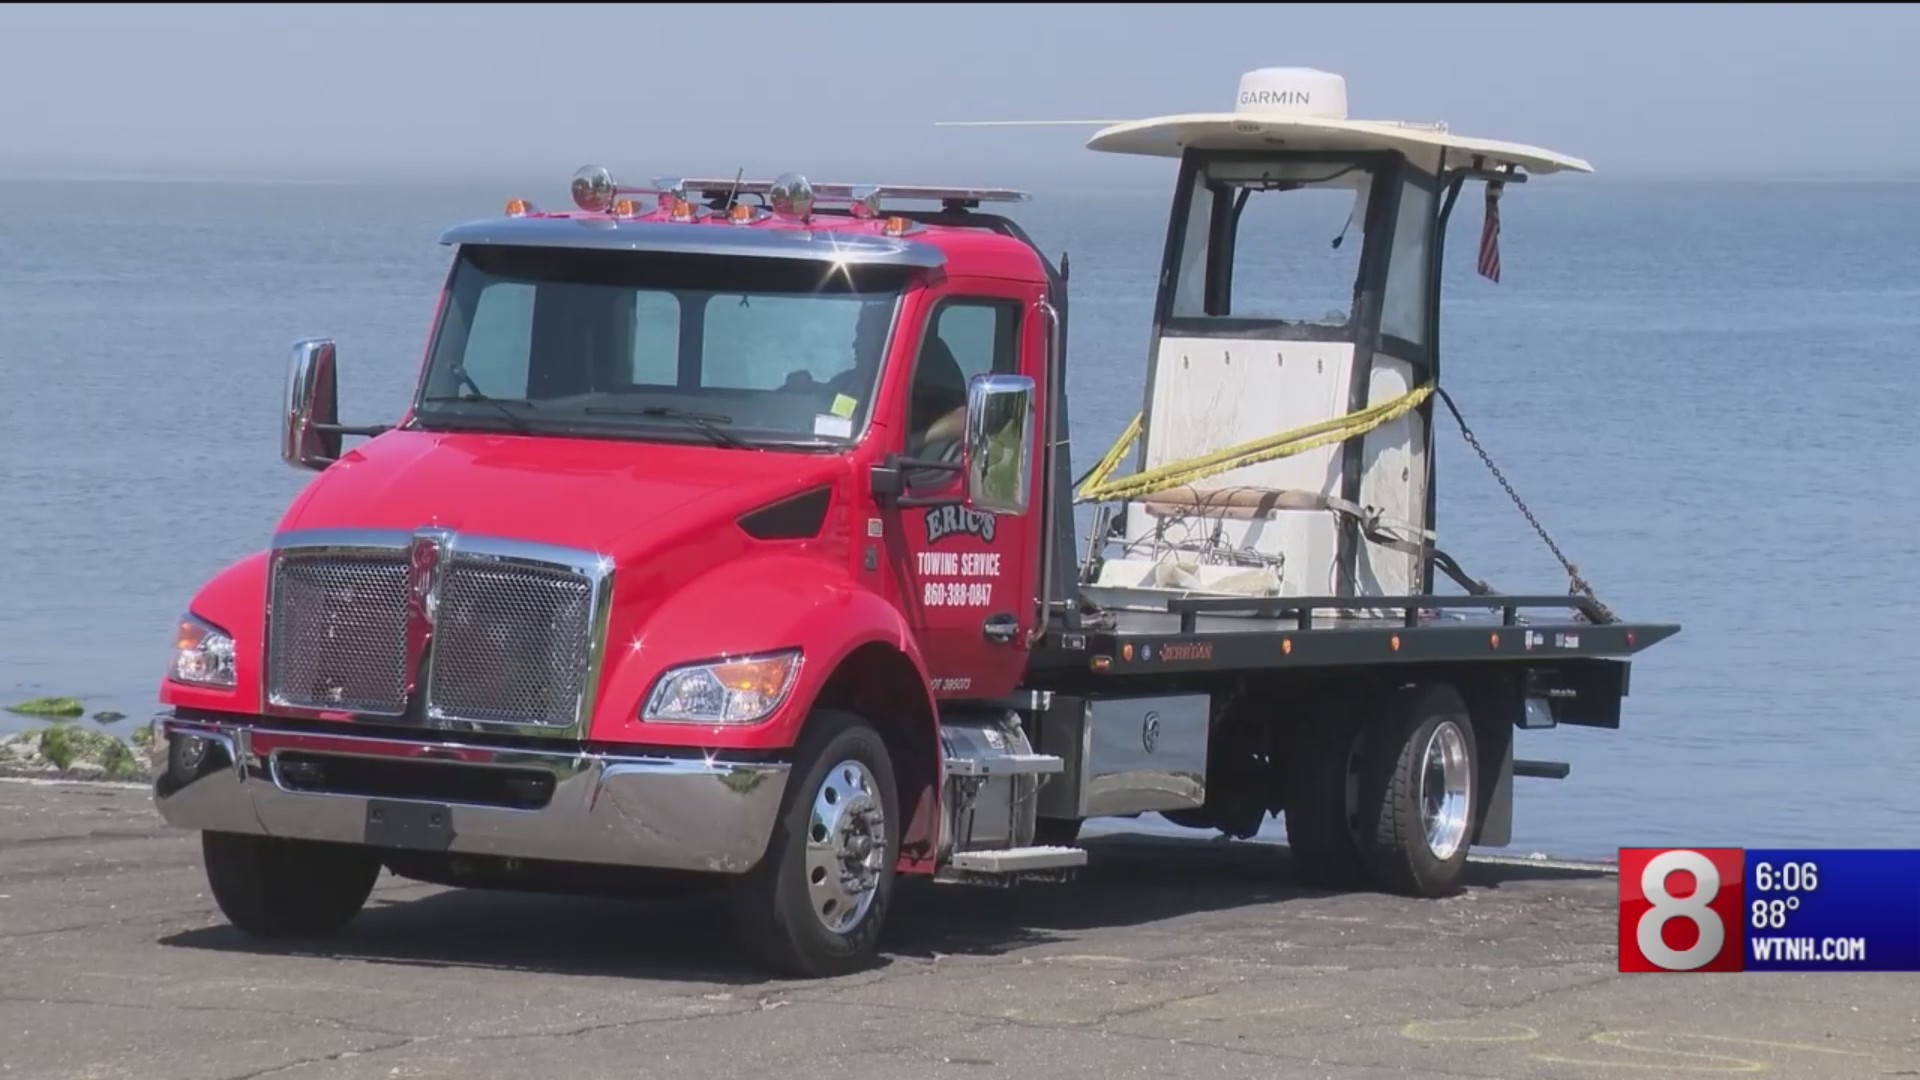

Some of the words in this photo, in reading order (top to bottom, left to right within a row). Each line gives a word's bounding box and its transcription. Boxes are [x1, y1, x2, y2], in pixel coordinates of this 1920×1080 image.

[1240, 90, 1310, 105] GARMIN
[925, 504, 996, 542] ERIC'S
[917, 552, 958, 575] TOWING
[961, 552, 1001, 576] SERVICE
[924, 582, 992, 606] 860-388-0847
